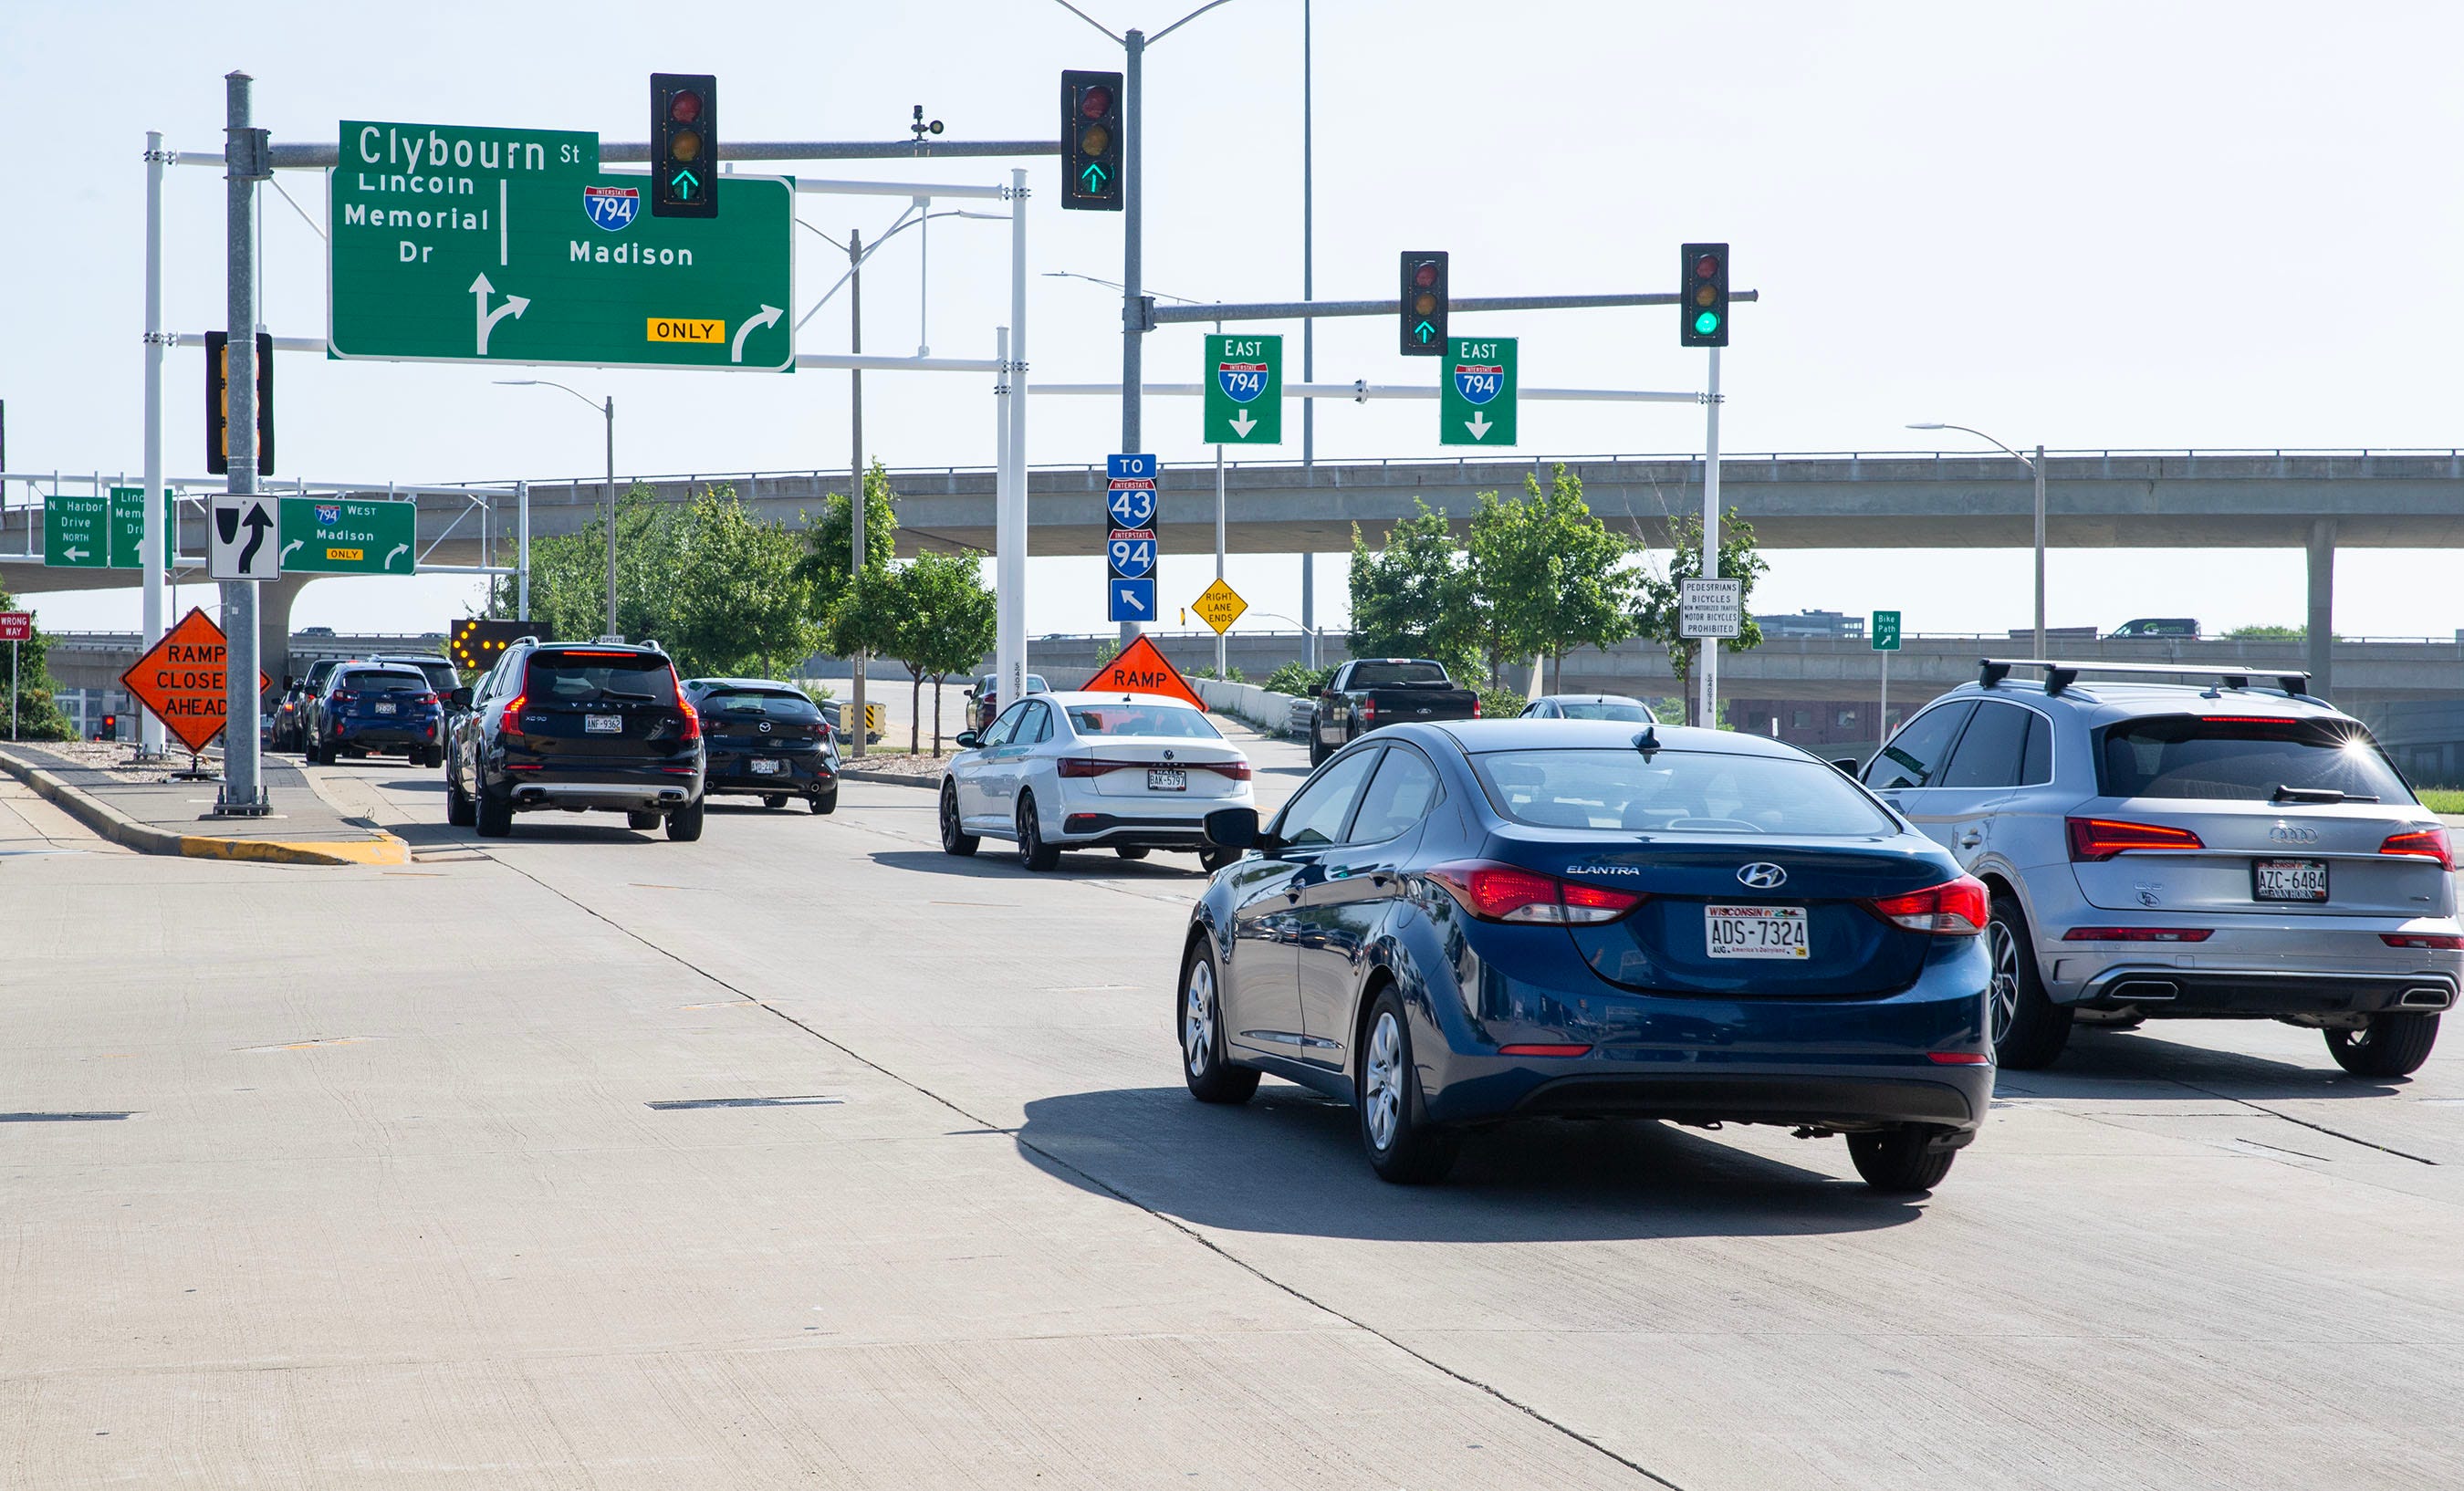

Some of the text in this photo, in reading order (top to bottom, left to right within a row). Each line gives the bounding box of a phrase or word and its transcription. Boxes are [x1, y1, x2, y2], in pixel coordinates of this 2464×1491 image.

[360, 125, 580, 174] Clybourn St
[344, 203, 488, 230] Memorial
[592, 197, 632, 223] 794
[400, 241, 433, 263] Dr
[569, 240, 693, 266] Madison
[656, 322, 715, 339] ONLY
[1225, 339, 1262, 357] EAST
[1461, 341, 1498, 359] EAST
[1227, 373, 1259, 392] 794
[1463, 375, 1495, 393] 794
[1119, 459, 1143, 474] TO
[48, 500, 103, 512] N. Harbor
[1112, 491, 1152, 518] 43
[318, 509, 338, 522] 794
[347, 505, 377, 516] WEST
[61, 516, 90, 527] Drive
[63, 533, 89, 542] NORTH
[317, 529, 374, 541] Madison
[330, 549, 359, 558] ONLY
[1112, 541, 1151, 568] 94
[1686, 583, 1737, 592] PEDESTRIANS
[1206, 592, 1232, 601] RIGHT
[1692, 595, 1731, 603] BICYCLES
[1207, 603, 1232, 611] LANE
[1, 617, 27, 626] WRONG
[1209, 614, 1233, 622] ENDS
[1707, 613, 1738, 621] BICYCLES
[1878, 614, 1895, 623] Bike
[5, 628, 22, 636] WAY
[1687, 624, 1734, 632] PROHIBITED
[1878, 625, 1896, 633] Path
[168, 645, 226, 662] RAMP
[157, 672, 226, 689] CLOSE
[1113, 670, 1167, 689] RAMP
[164, 698, 226, 716] AHEAD
[587, 720, 621, 729] ANF-9362
[1150, 775, 1185, 786] BAK-5797
[1566, 865, 1640, 876] ELANTRA
[2260, 871, 2325, 890] AZC-6484
[1708, 906, 1763, 917] WISCONSIN
[1712, 919, 1805, 946] ADS-7324
